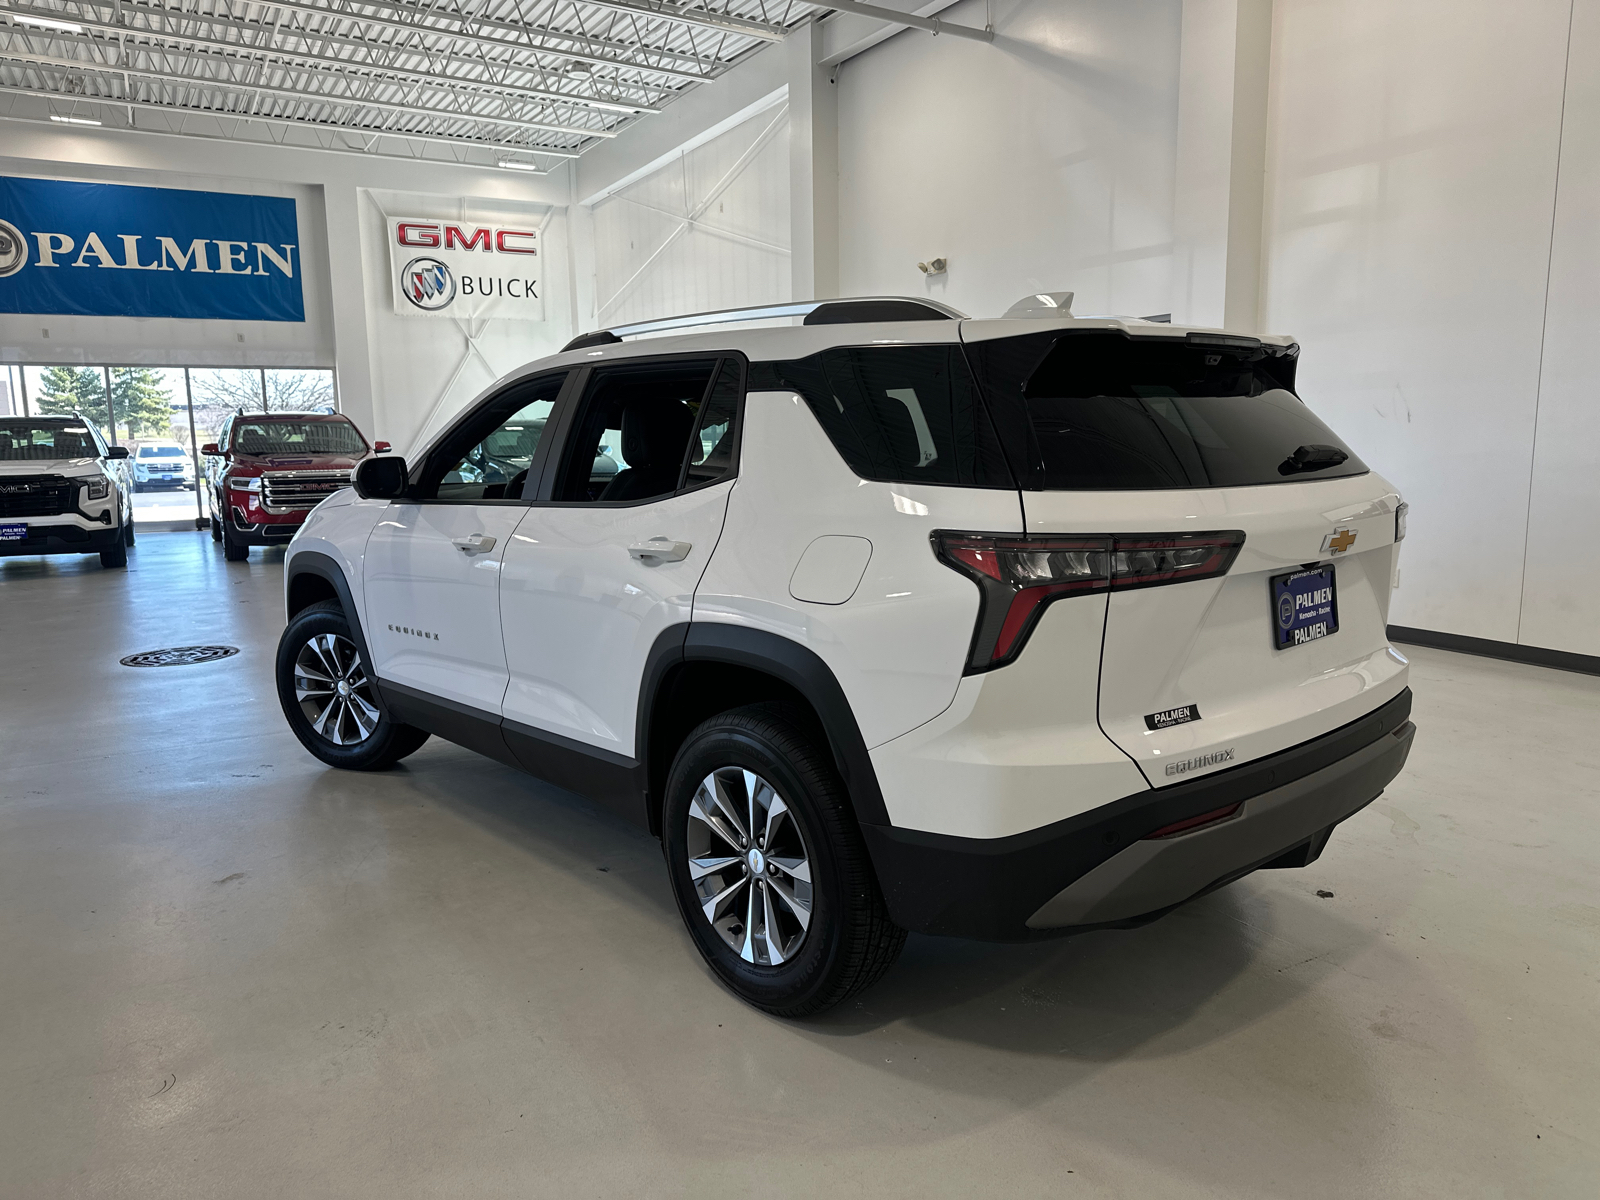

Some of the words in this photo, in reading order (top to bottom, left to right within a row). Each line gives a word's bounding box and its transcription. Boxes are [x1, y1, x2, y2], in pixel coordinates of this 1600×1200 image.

[396, 221, 537, 256] GMC
[30, 231, 296, 278] PALMEN
[461, 275, 539, 299] BUICK
[1290, 568, 1323, 581] palmen.com
[1296, 587, 1332, 610] PALMEN
[1299, 610, 1316, 620] Kenosha
[1318, 606, 1331, 615] Racine
[1294, 621, 1327, 645] PALMEN
[1154, 706, 1190, 724] PALMEN
[1165, 747, 1235, 777] EQUINOX
